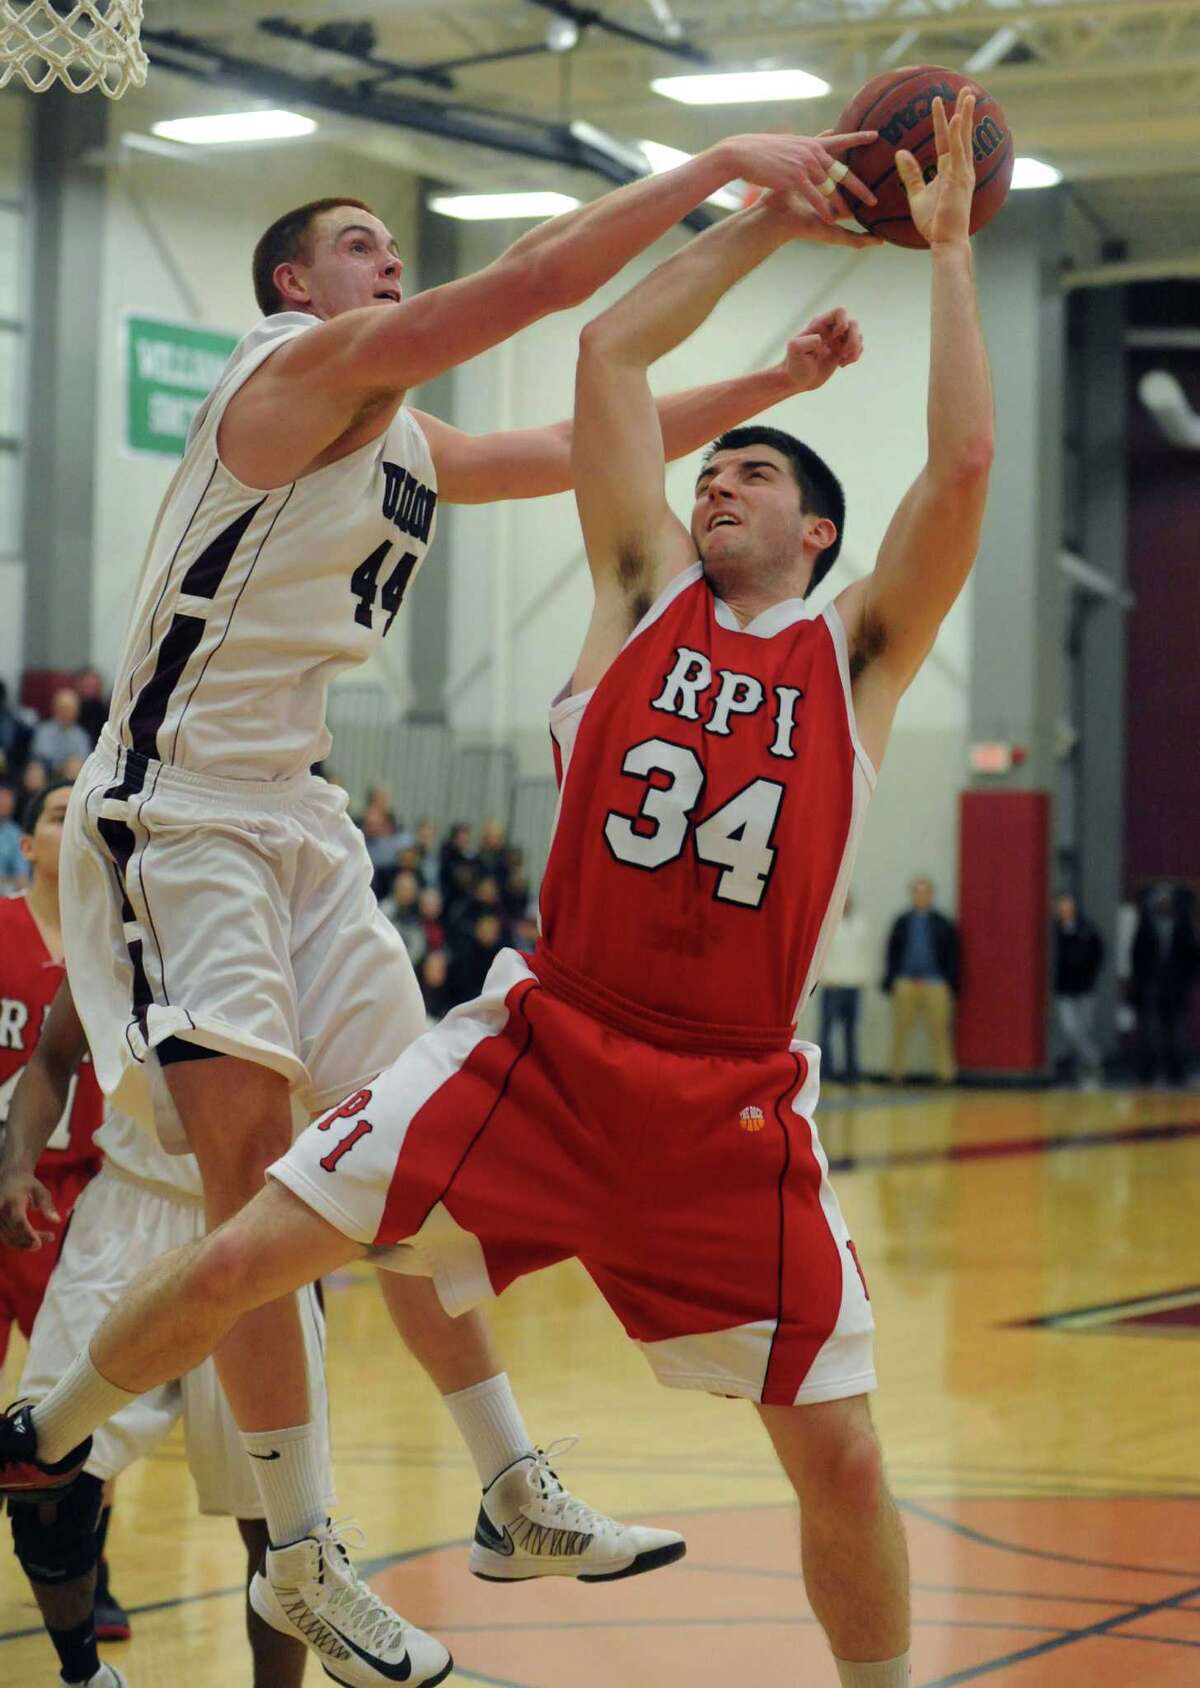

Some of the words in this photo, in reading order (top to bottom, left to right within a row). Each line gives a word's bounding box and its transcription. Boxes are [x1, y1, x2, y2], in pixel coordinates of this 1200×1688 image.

[351, 538, 419, 638] 44
[650, 646, 803, 759] RPI
[603, 736, 787, 910] 34
[317, 1088, 374, 1173] PI
